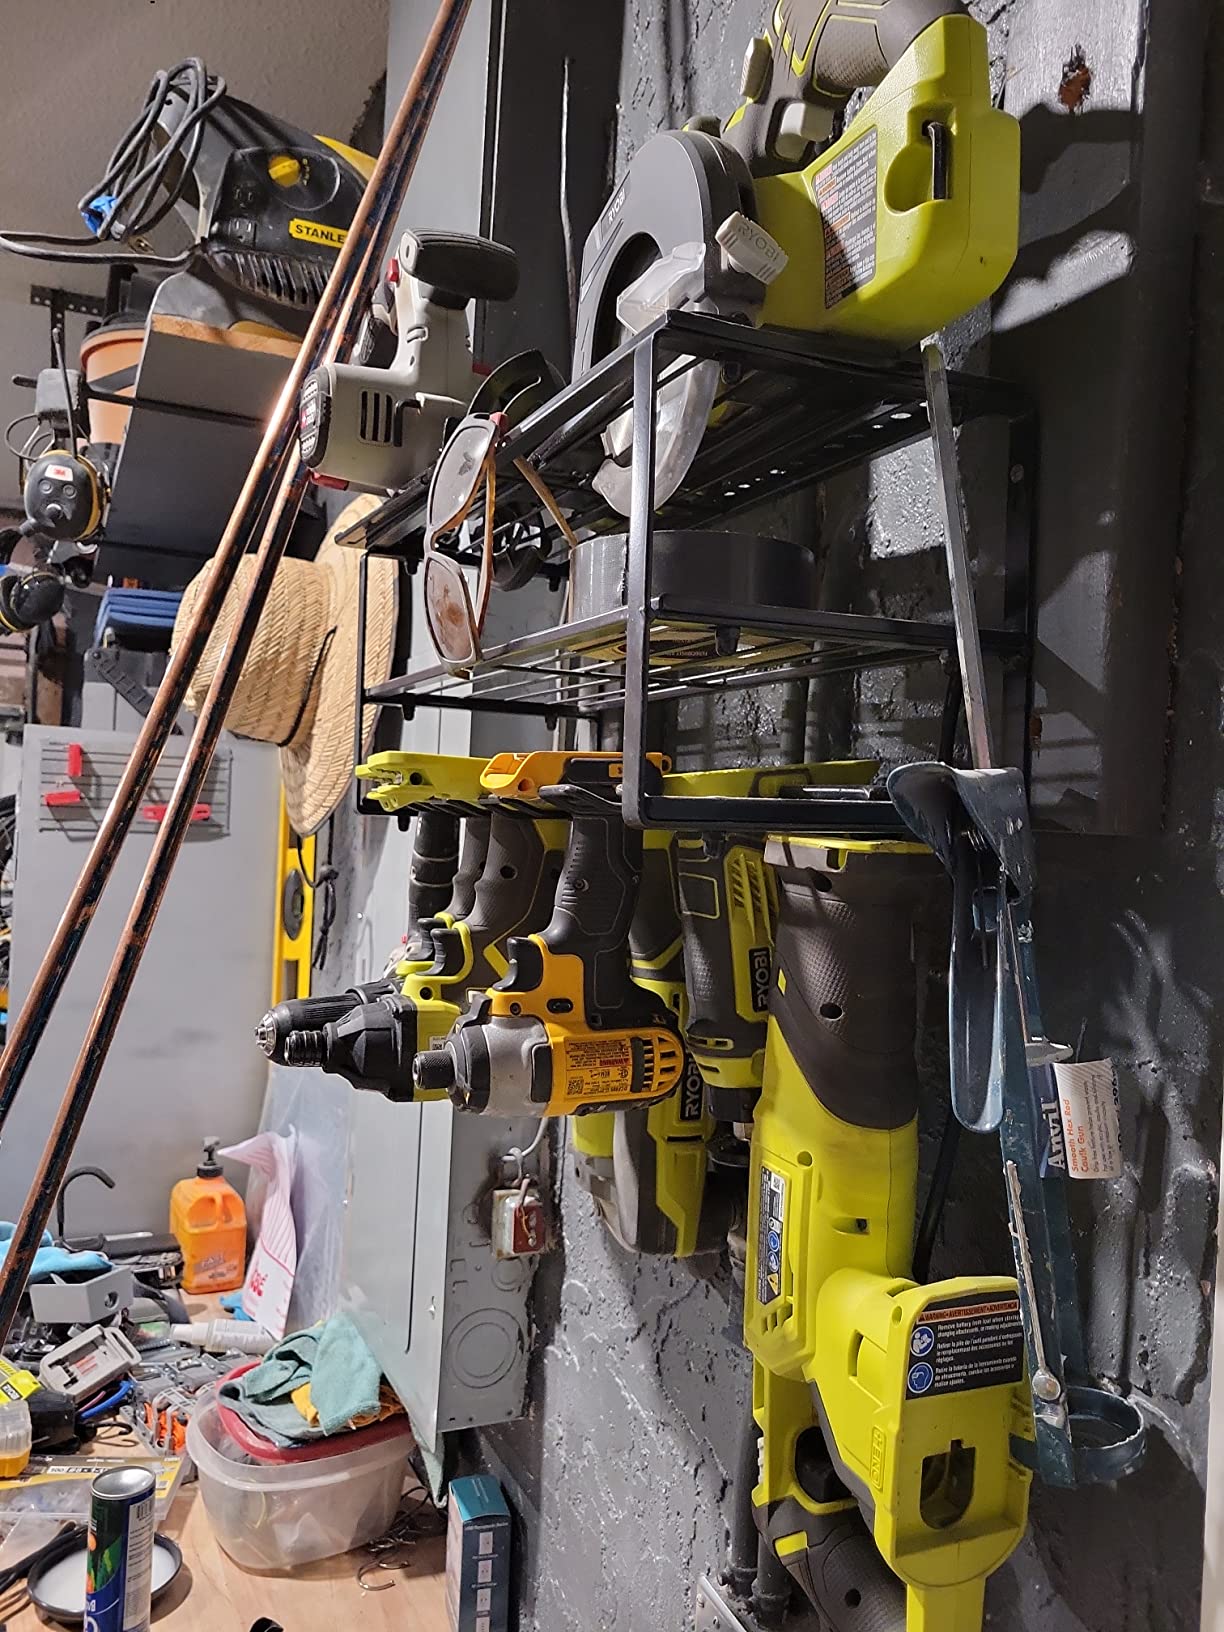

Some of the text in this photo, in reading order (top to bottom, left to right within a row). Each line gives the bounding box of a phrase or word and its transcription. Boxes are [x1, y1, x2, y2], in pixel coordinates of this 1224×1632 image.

[296, 224, 346, 243] STANLE
[737, 223, 778, 262] RYOBI
[753, 950, 769, 1009] RYOBI
[1041, 1101, 1065, 1170] Anvil
[1063, 1099, 1078, 1171] Smooth Hex Rod
[1075, 1125, 1088, 1171] Caulk Gun
